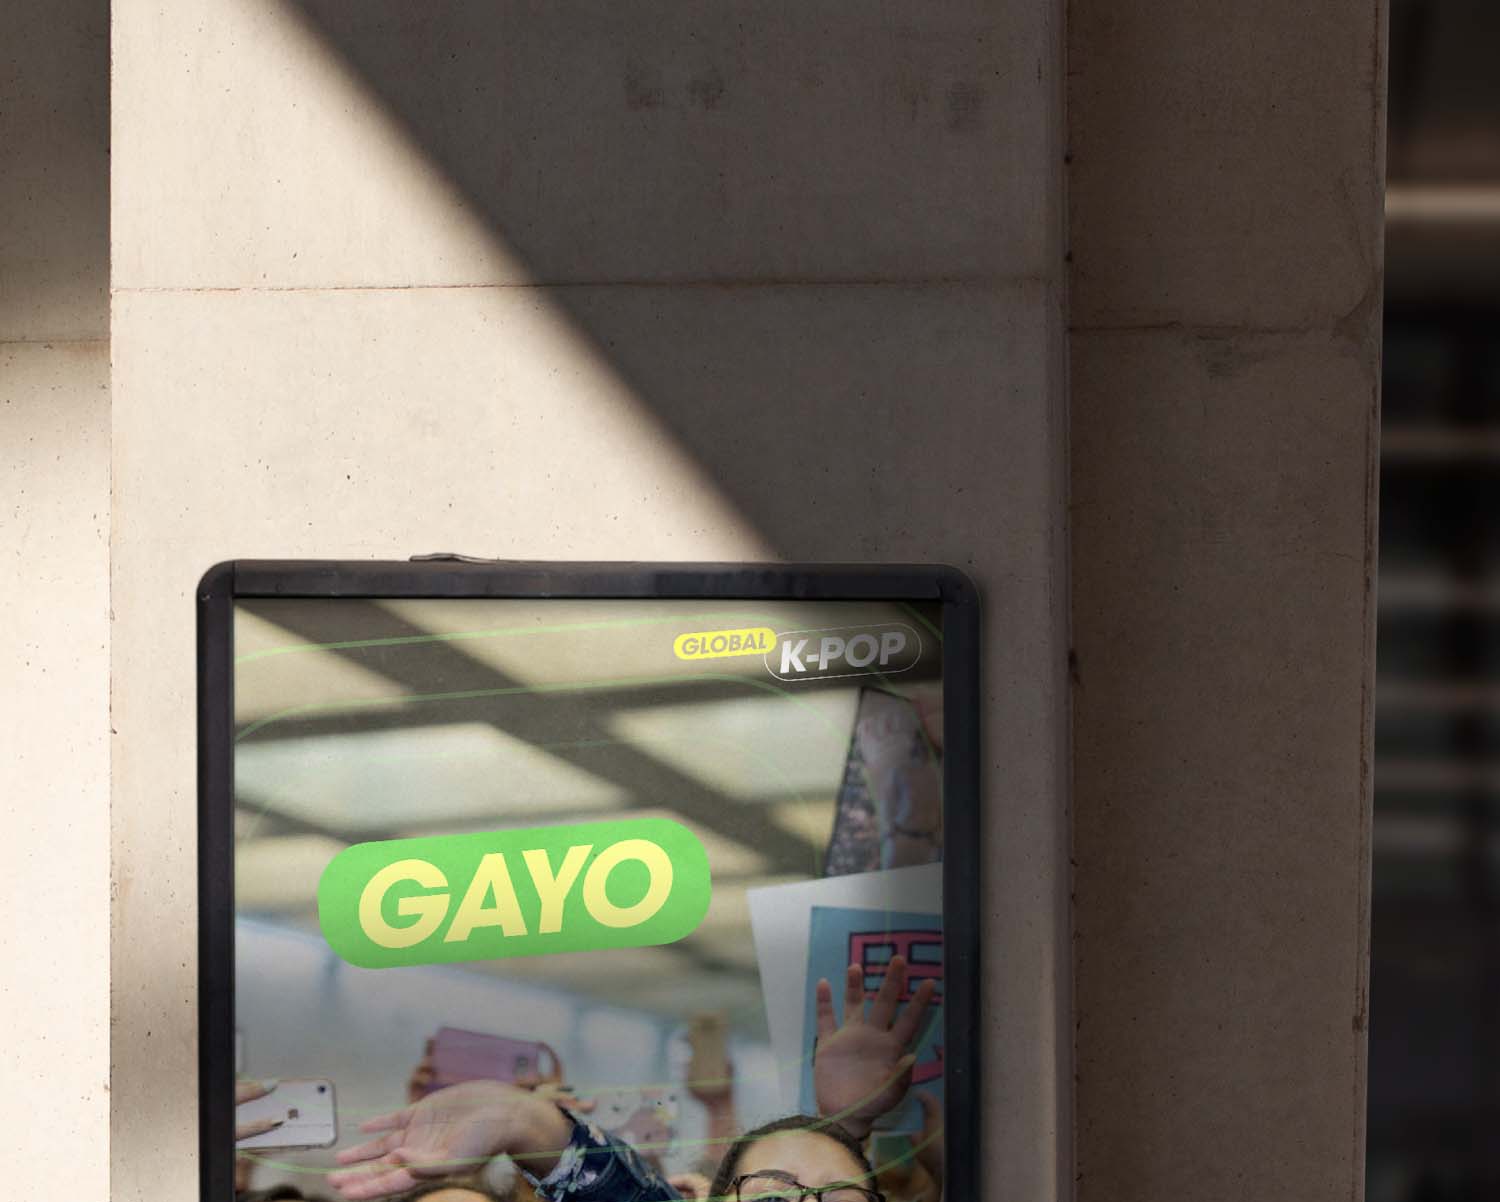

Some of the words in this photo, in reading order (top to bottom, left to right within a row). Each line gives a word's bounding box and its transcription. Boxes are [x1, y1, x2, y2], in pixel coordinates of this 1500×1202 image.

[681, 633, 768, 655] GLOBAL
[780, 632, 907, 673] K-POP
[359, 838, 673, 949] GAYO
